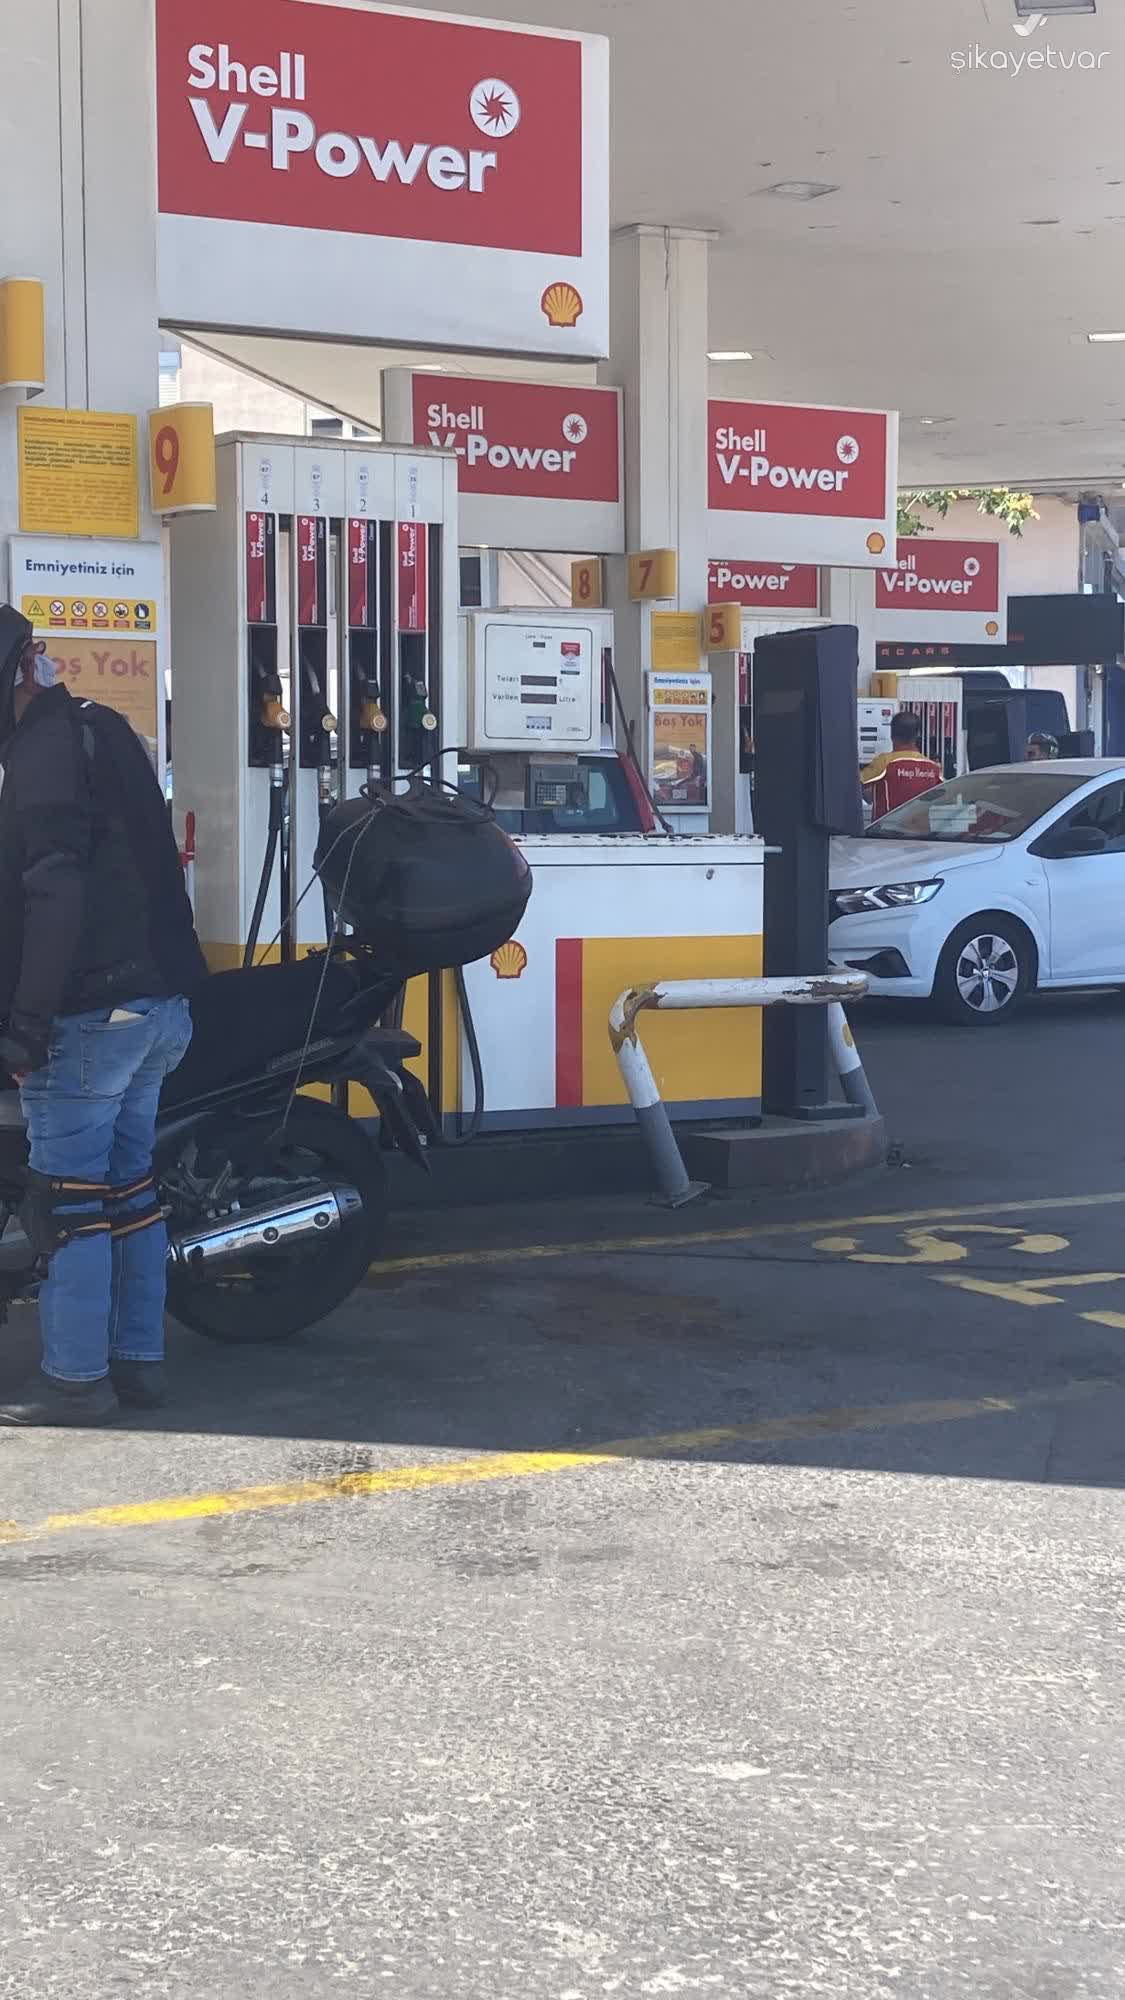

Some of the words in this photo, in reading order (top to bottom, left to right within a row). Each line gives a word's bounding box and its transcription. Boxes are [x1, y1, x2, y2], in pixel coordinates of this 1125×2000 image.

[187, 44, 306, 101] Shell
[188, 96, 497, 193] V-Power
[427, 403, 484, 430] Shell
[715, 427, 766, 452] Shell
[155, 425, 179, 494] 9
[716, 453, 848, 491] V-Power
[261, 492, 269, 505] 4
[312, 498, 320, 511] 3
[359, 498, 367, 512] 2
[410, 505, 416, 518] 1
[256, 518, 265, 558] V-Power
[308, 521, 316, 562] V-Power
[358, 524, 366, 564] V-Power
[25, 559, 108, 577] Emniyetiniz
[111, 561, 135, 579] için
[638, 559, 653, 593] 7
[896, 555, 916, 570] ell
[579, 568, 591, 600] 8
[708, 567, 789, 591] -Power
[881, 571, 973, 595] V-Power
[709, 612, 725, 645] 5
[91, 650, 150, 678] Yok
